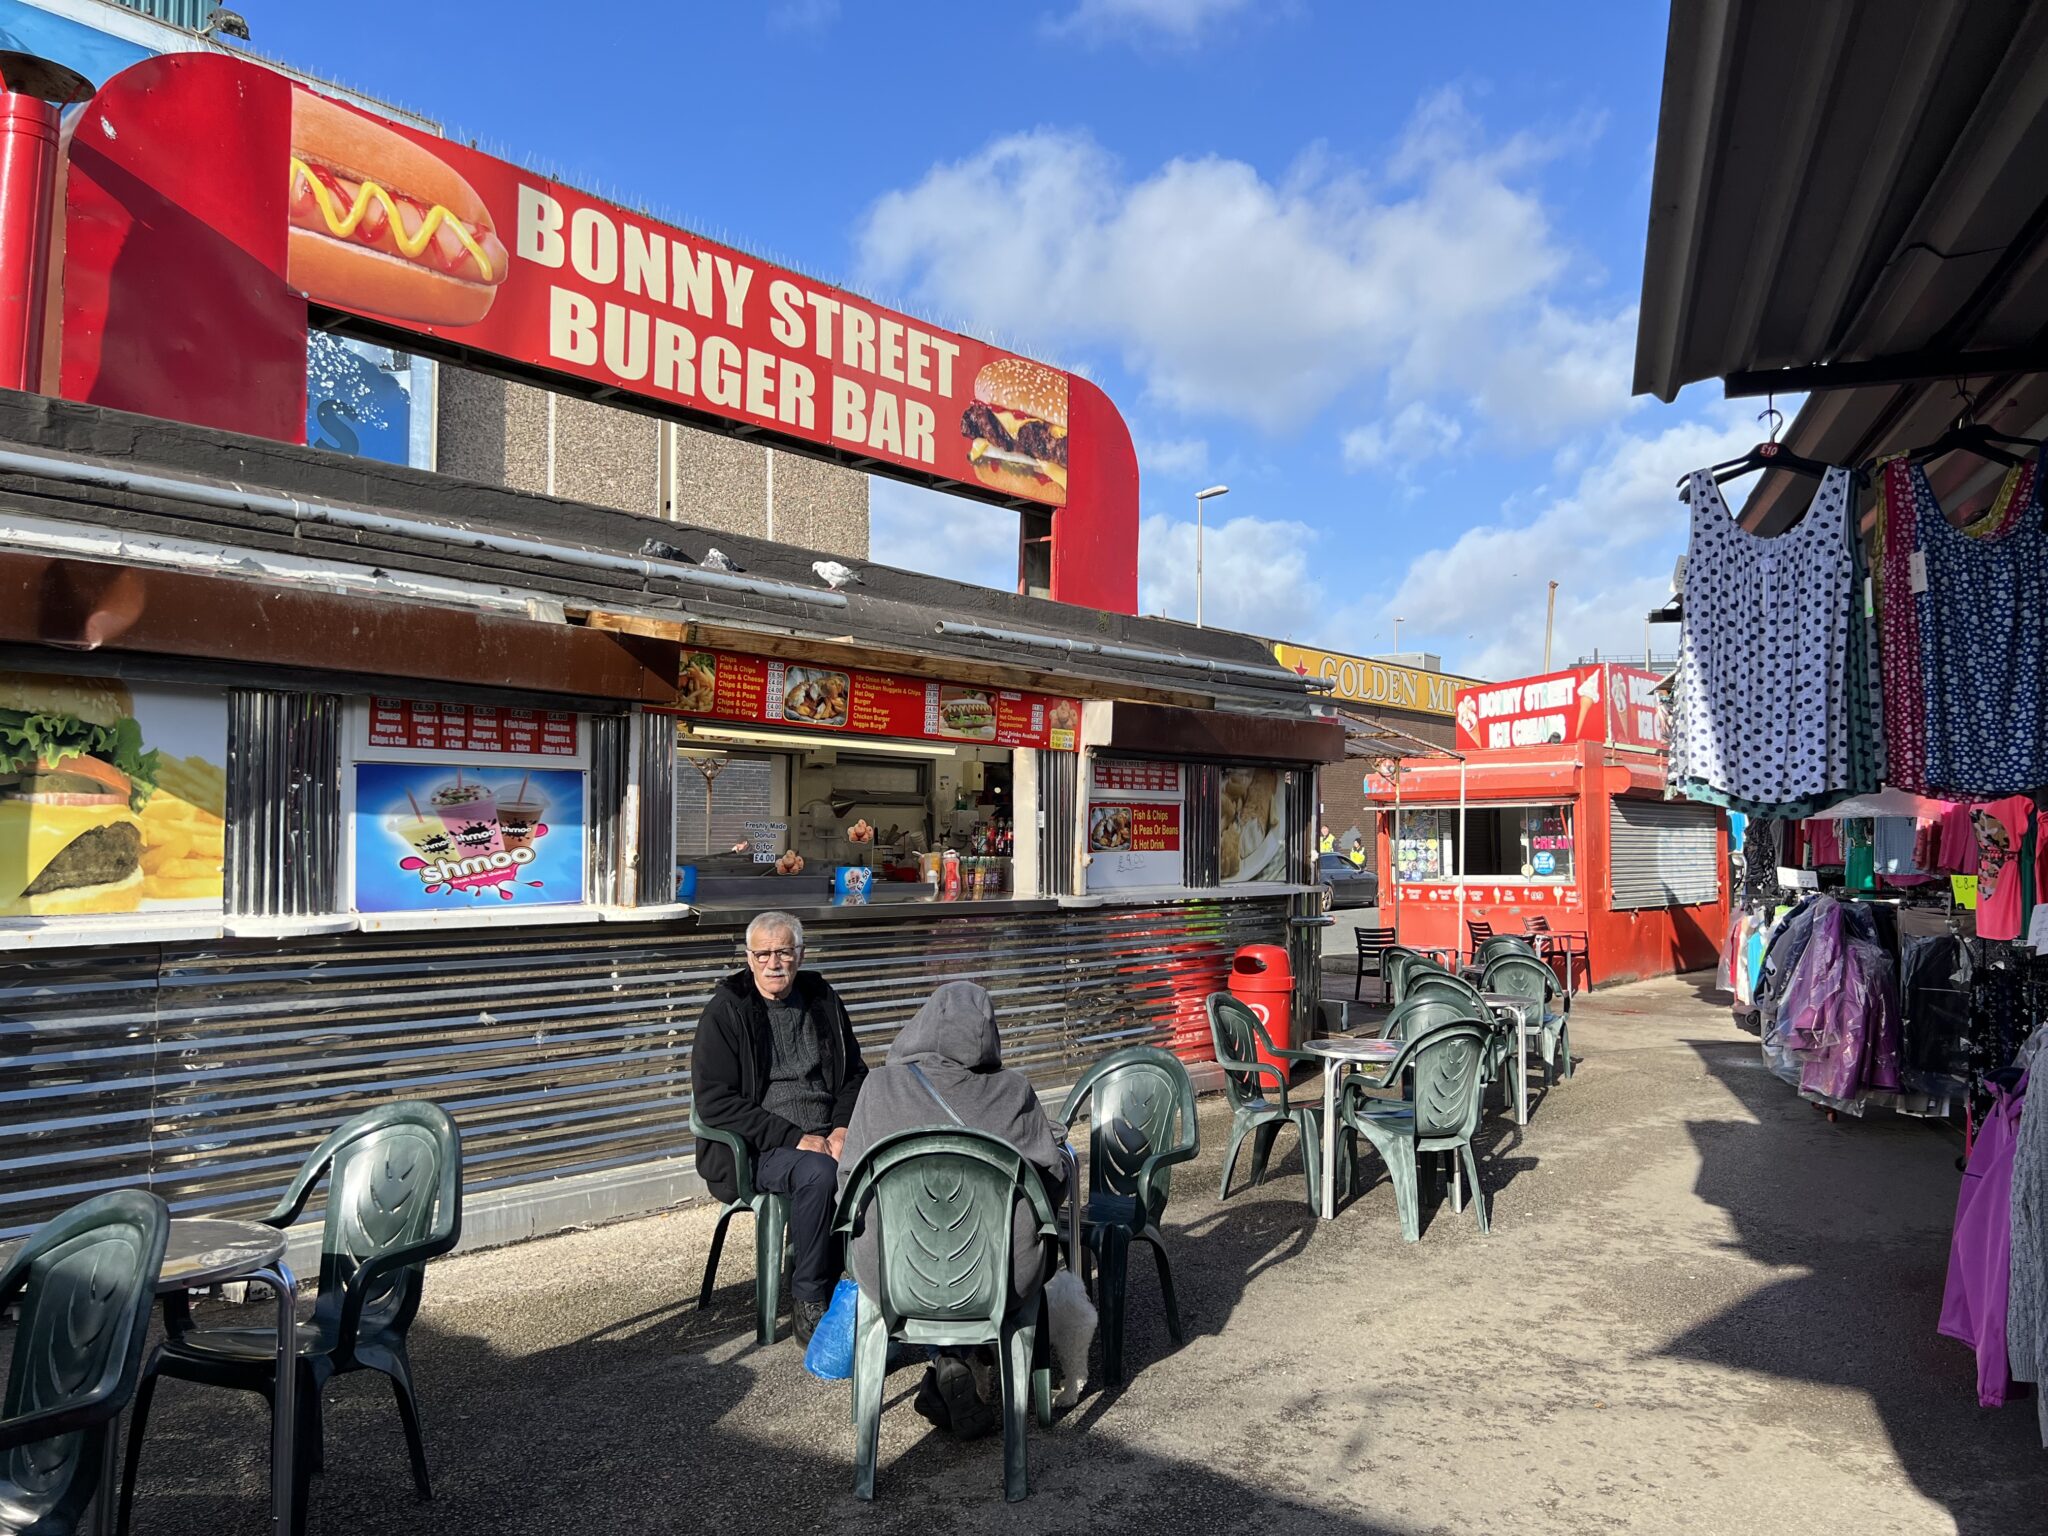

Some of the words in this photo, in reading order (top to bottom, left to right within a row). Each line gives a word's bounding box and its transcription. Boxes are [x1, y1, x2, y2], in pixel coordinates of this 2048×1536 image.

[517, 183, 754, 328] BONNY
[769, 280, 960, 398] STREET
[550, 285, 815, 430] BURGER
[832, 374, 935, 465] BAR
[720, 663, 732, 671] Fish
[740, 665, 756, 674] Chips
[719, 672, 736, 680] Chips
[743, 674, 764, 683] Cheese
[718, 680, 736, 689] Chips
[743, 683, 760, 691] Beans
[1319, 656, 1418, 706] GOLDEN
[1427, 676, 1476, 713] MI
[718, 689, 735, 697] Chips
[742, 691, 756, 699] Peas
[865, 691, 874, 699] Dog
[1479, 686, 1524, 719] BONNY
[1523, 677, 1576, 712] STREET
[717, 698, 734, 706] Chips
[742, 700, 758, 709] Curry
[717, 707, 734, 715] Chips
[853, 705, 871, 713] Cheese
[873, 707, 889, 715] Burger
[413, 713, 433, 723] Burger
[853, 712, 872, 720] Chicken
[376, 723, 397, 733] Burger
[398, 725, 403, 733] &
[473, 718, 496, 728] Chicken
[508, 720, 518, 729] Fish
[519, 721, 538, 730] Fingers
[549, 723, 570, 732] Chicken
[853, 720, 869, 729] Veggie
[417, 726, 434, 735] Chips
[448, 727, 465, 737] Chips
[472, 729, 492, 739] Burger
[1489, 721, 1511, 749] ICE
[1512, 713, 1566, 747] CREAMS
[371, 735, 388, 744] Chips
[510, 732, 514, 740] &
[515, 732, 531, 741] Chips
[544, 734, 565, 743] Nuggets
[468, 741, 484, 750] Chips
[485, 742, 489, 750] &
[516, 743, 530, 752] Juice
[1133, 809, 1145, 820] Fish
[1147, 810, 1151, 819] &
[1152, 810, 1168, 822] Chips
[745, 822, 768, 831] Freshly
[769, 822, 787, 830] Made
[1133, 826, 1137, 835] &
[1139, 825, 1153, 835] Peas
[1154, 825, 1161, 835] Or
[1162, 825, 1178, 835] Beans
[455, 829, 496, 842] shmoo
[754, 831, 776, 839] Donuts
[763, 842, 774, 850] for
[1133, 840, 1137, 849] &
[1139, 839, 1149, 849] Hot
[1150, 839, 1165, 849] Drink
[754, 854, 775, 862] £4.00
[421, 847, 536, 884] shmoo
